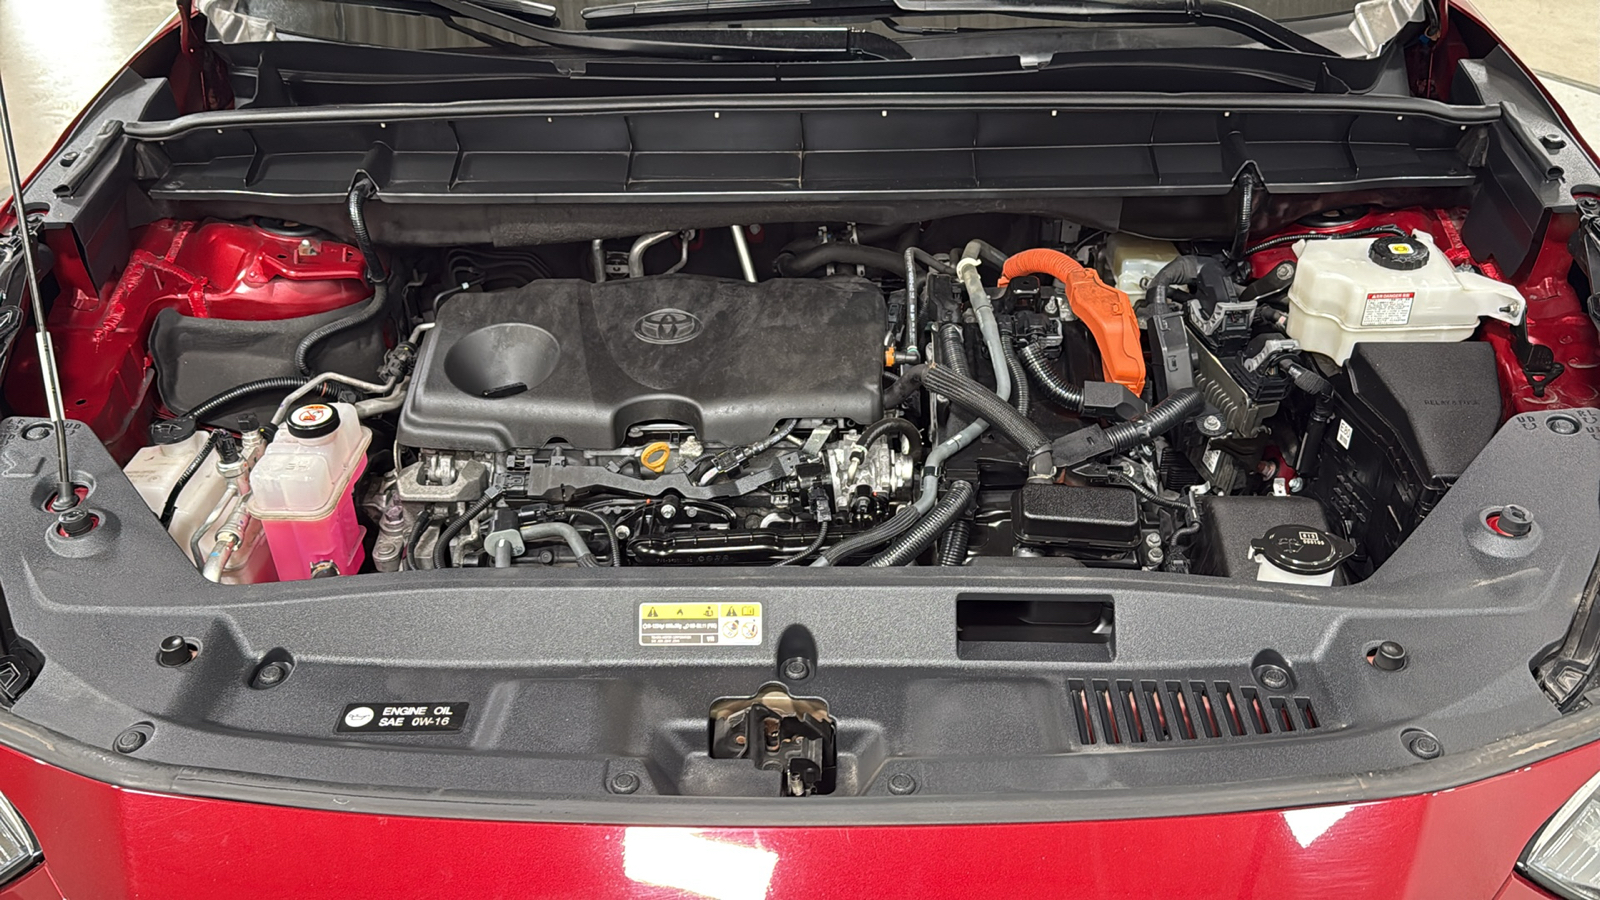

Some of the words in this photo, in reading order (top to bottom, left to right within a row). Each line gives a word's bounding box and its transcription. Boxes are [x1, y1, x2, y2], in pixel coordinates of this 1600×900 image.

[382, 706, 428, 715] ENGINE
[433, 706, 453, 715] OIL
[378, 717, 405, 727] SAE
[411, 717, 450, 726] 0W-16
